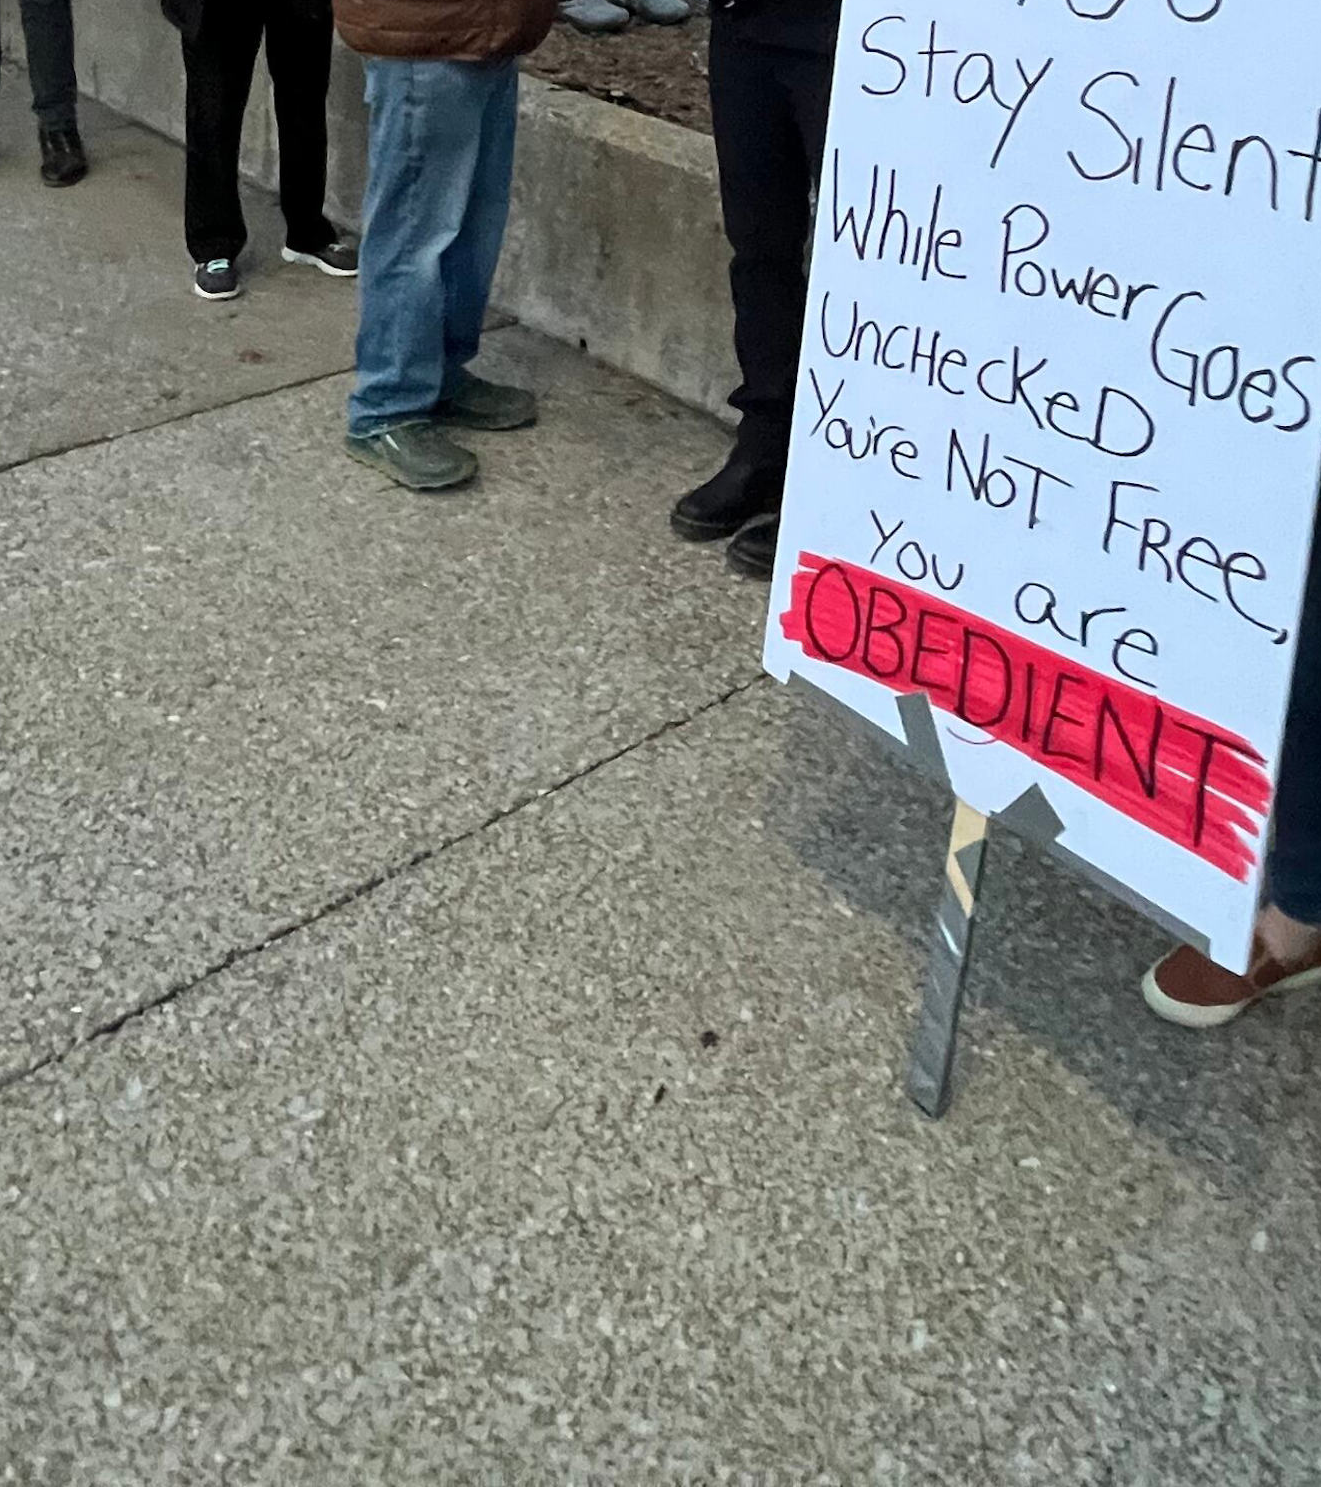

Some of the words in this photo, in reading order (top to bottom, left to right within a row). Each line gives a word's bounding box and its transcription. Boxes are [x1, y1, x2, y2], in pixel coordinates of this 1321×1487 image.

[860, 15, 1054, 169] Stay
[833, 147, 967, 281] While
[1000, 203, 1160, 321] Power
[805, 561, 1269, 848] OBEDIENT
[1014, 581, 1159, 688] are
